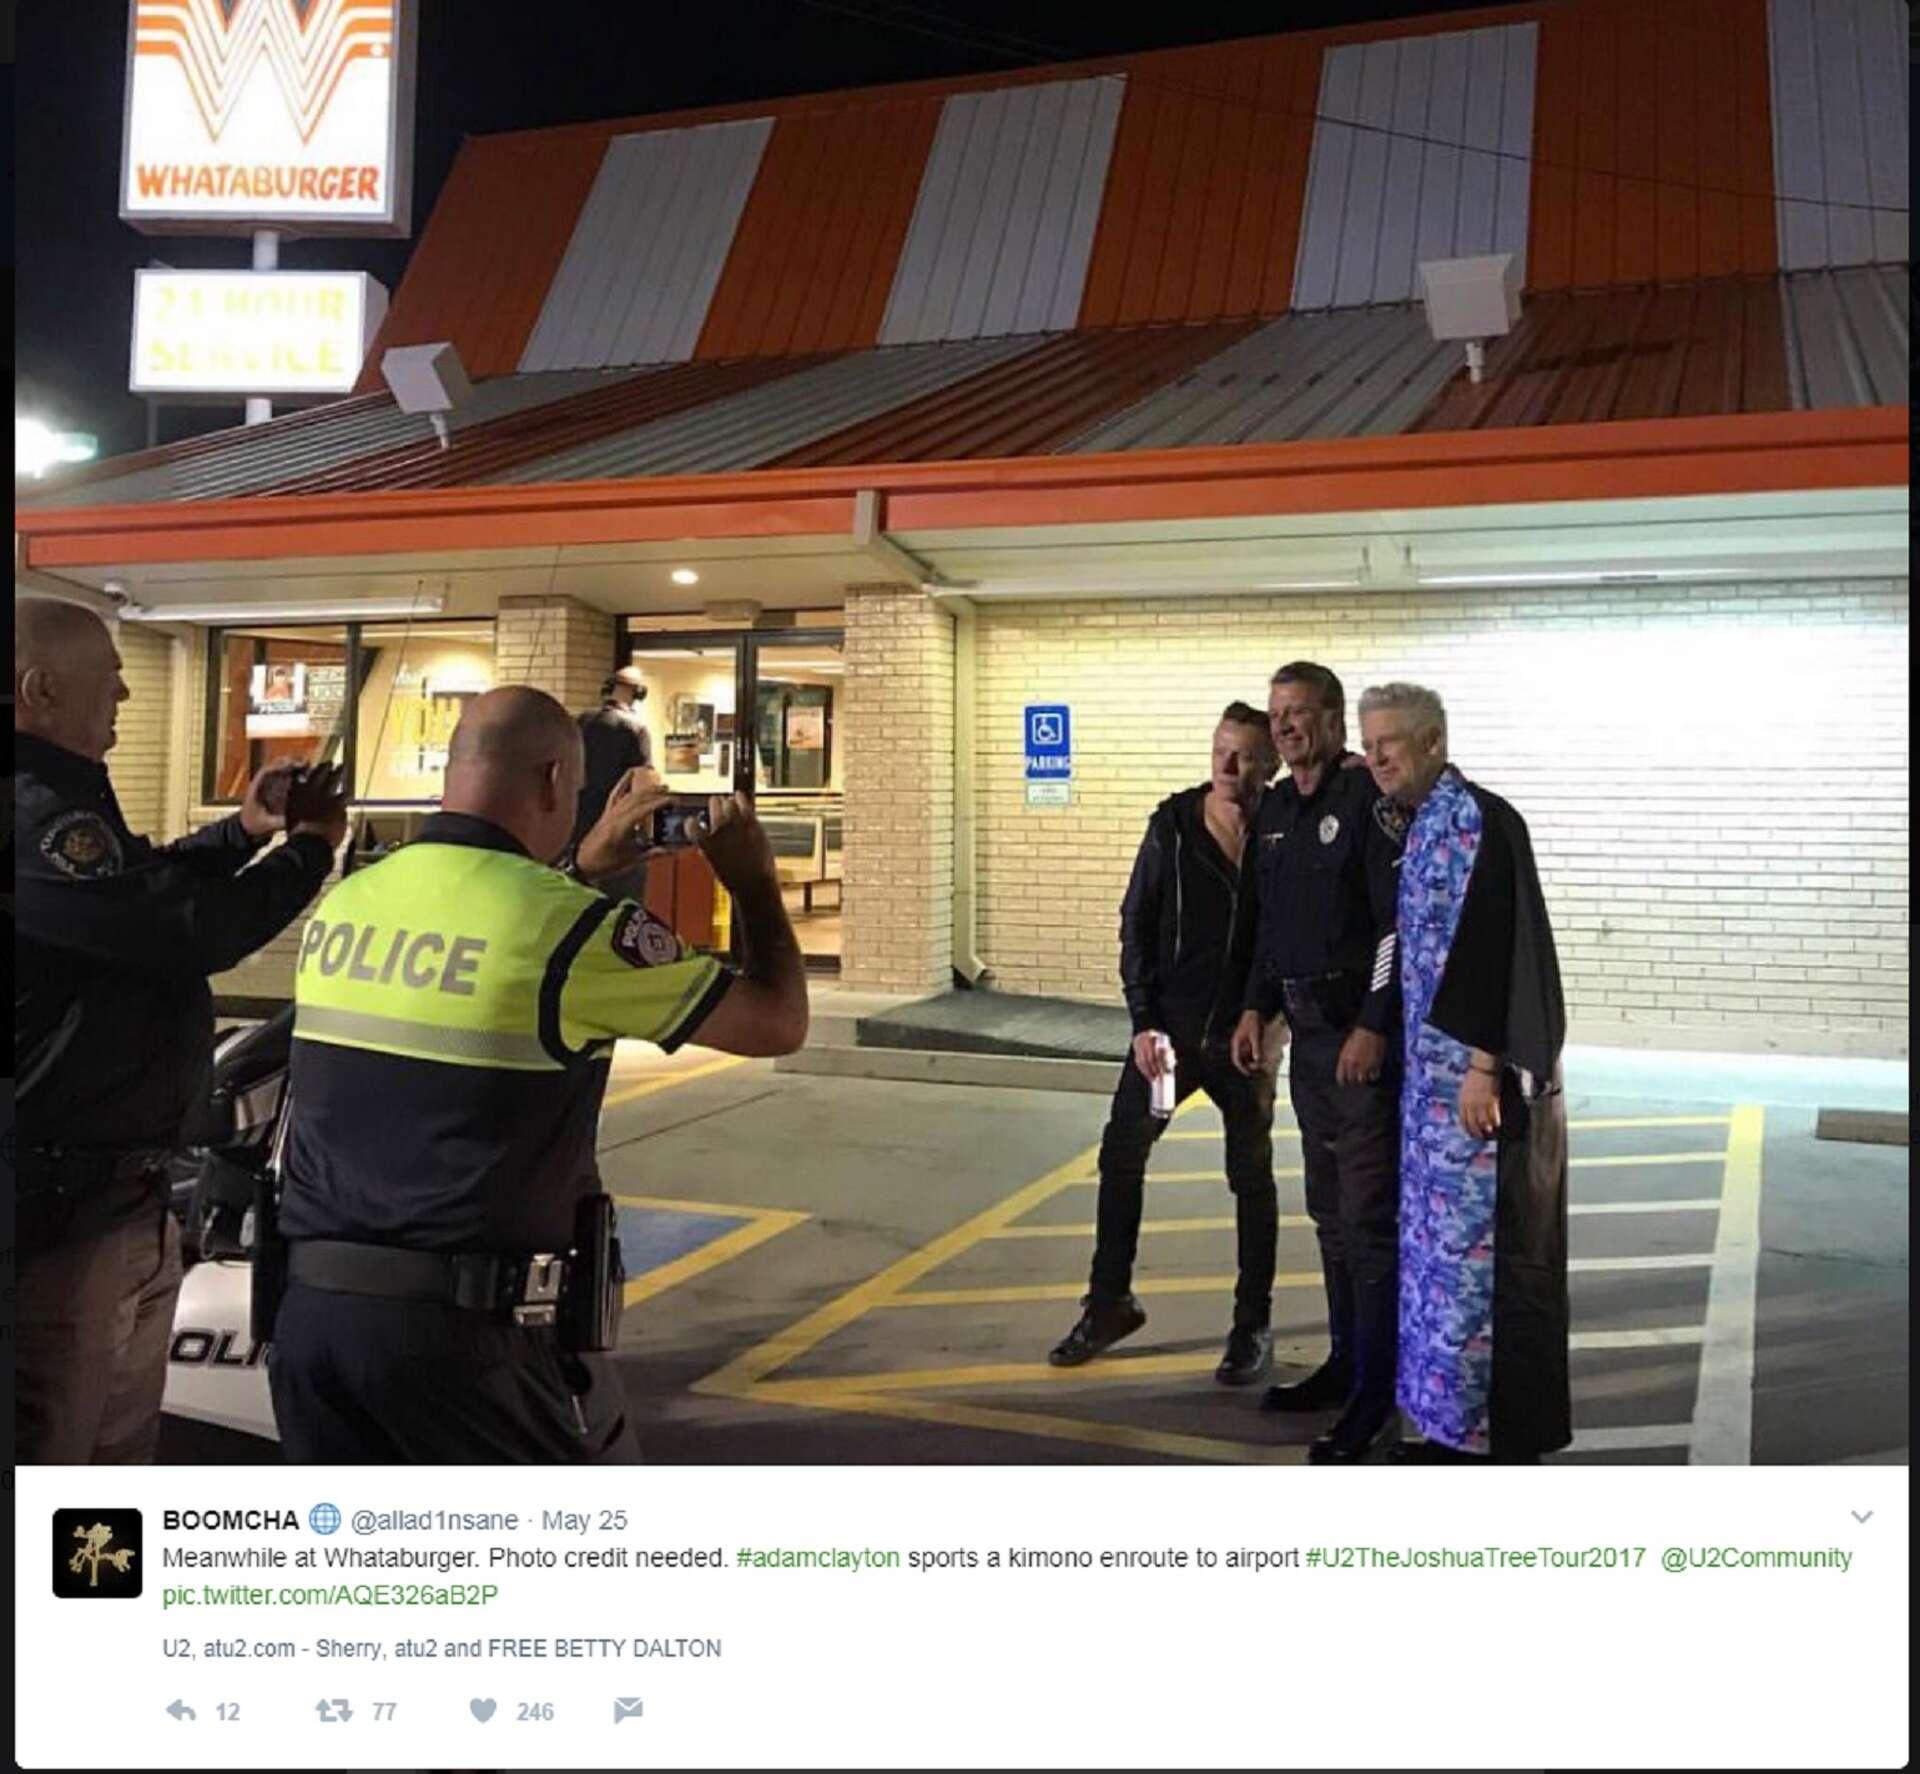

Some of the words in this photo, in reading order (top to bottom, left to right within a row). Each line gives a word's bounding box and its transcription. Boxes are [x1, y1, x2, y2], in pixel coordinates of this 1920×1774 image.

[136, 163, 380, 201] WHATABURGER
[149, 339, 345, 376] SEICE
[298, 919, 487, 996] POLICE
